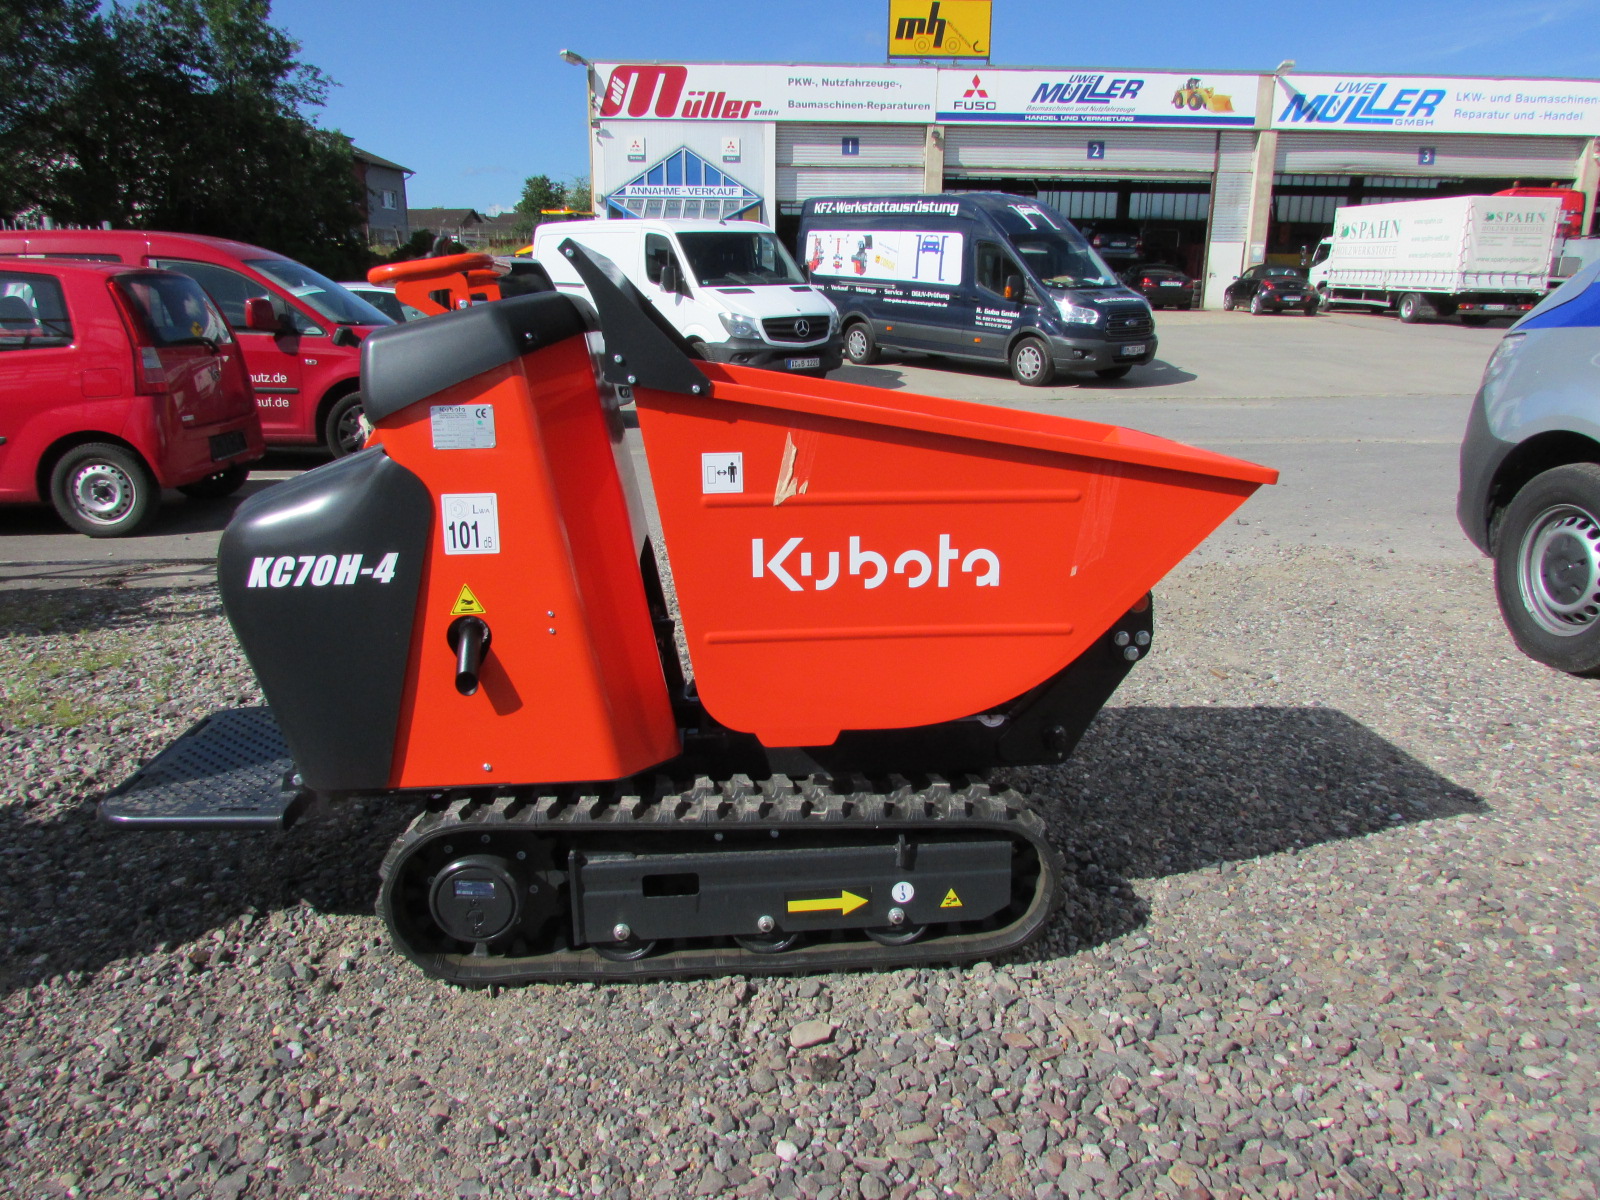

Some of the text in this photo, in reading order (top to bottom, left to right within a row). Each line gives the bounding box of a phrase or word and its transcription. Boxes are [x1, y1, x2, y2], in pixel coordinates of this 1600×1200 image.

[895, 1, 946, 48] mh
[787, 78, 902, 89] PKW-, Nutzfahrzeuge-,
[1069, 75, 1098, 84] UWE
[599, 65, 762, 118] Müller
[1030, 75, 1145, 104] MÜLLER
[1334, 82, 1378, 94] UWE
[1277, 82, 1447, 125] MÜLLER
[1456, 92, 1485, 102] LKW-
[1490, 93, 1511, 103] und
[787, 100, 930, 111] Baumaschinen-Reparaturen
[953, 101, 996, 111] FUSO
[1454, 109, 1584, 121] Reparatur und -Handel
[1092, 144, 1100, 157] 2
[1422, 150, 1431, 163] 3
[814, 200, 959, 217] KFZ-Werkstattausrüstung
[1495, 212, 1546, 223] SPAHN
[1350, 220, 1401, 239] SPAHN
[1336, 246, 1397, 256] HOLZWERKSTOFFE
[884, 288, 903, 296] Service
[475, 408, 487, 419] CE
[448, 520, 480, 549] 101
[483, 536, 493, 549] dB
[751, 533, 1000, 592] Kubota
[246, 552, 400, 588] KC70H-4
